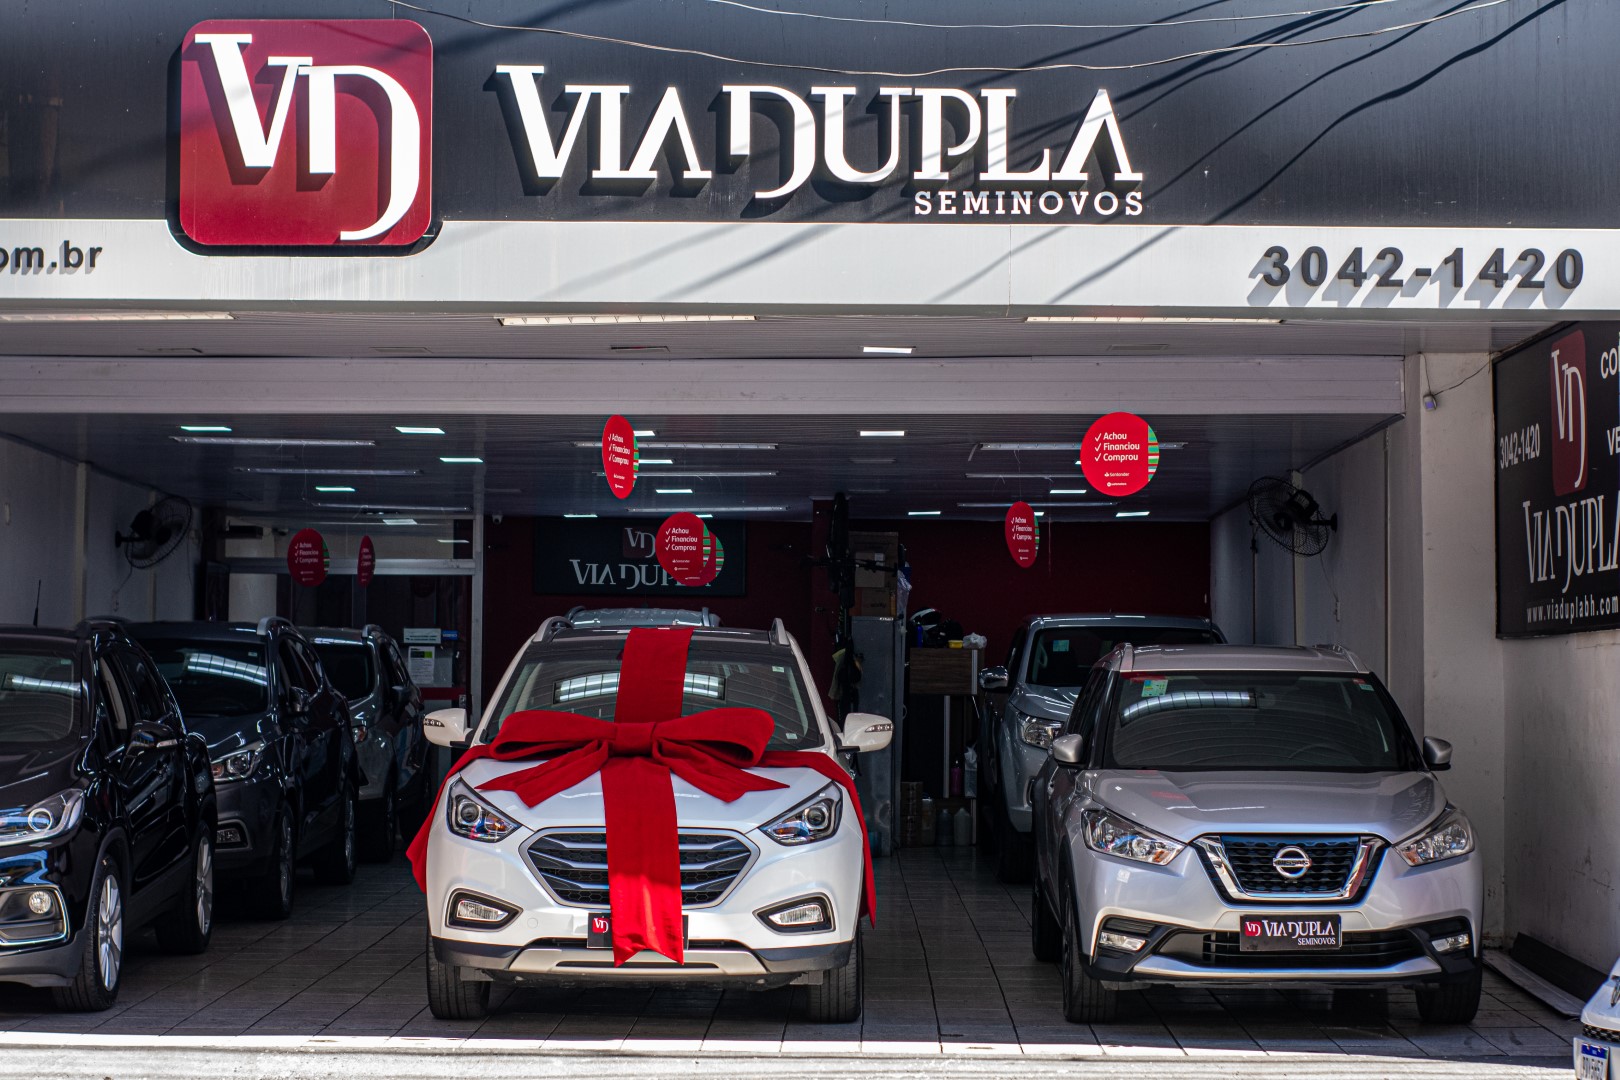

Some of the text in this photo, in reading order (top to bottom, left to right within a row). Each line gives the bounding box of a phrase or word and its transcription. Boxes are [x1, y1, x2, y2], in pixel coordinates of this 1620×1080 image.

[495, 65, 1143, 200] VIA DUPLA
[914, 190, 1143, 216] SEMINOVOS
[1263, 246, 1584, 289] 3042-1420
[1601, 345, 1620, 379] CO
[1103, 432, 1127, 440] Achou
[1103, 442, 1140, 450] Financiou
[1500, 423, 1540, 469] 3042-1420
[1103, 453, 1139, 463] Comprou
[671, 535, 698, 543] Financiou
[671, 544, 697, 552] Comprou
[1523, 501, 1556, 584] VIA
[569, 559, 711, 590] VIA DUP
[1526, 594, 1619, 624] www.viaduplabh.com
[1262, 920, 1288, 937] VIA
[1287, 921, 1335, 938] DUPLA
[1297, 937, 1336, 946] SEMINOVOS
